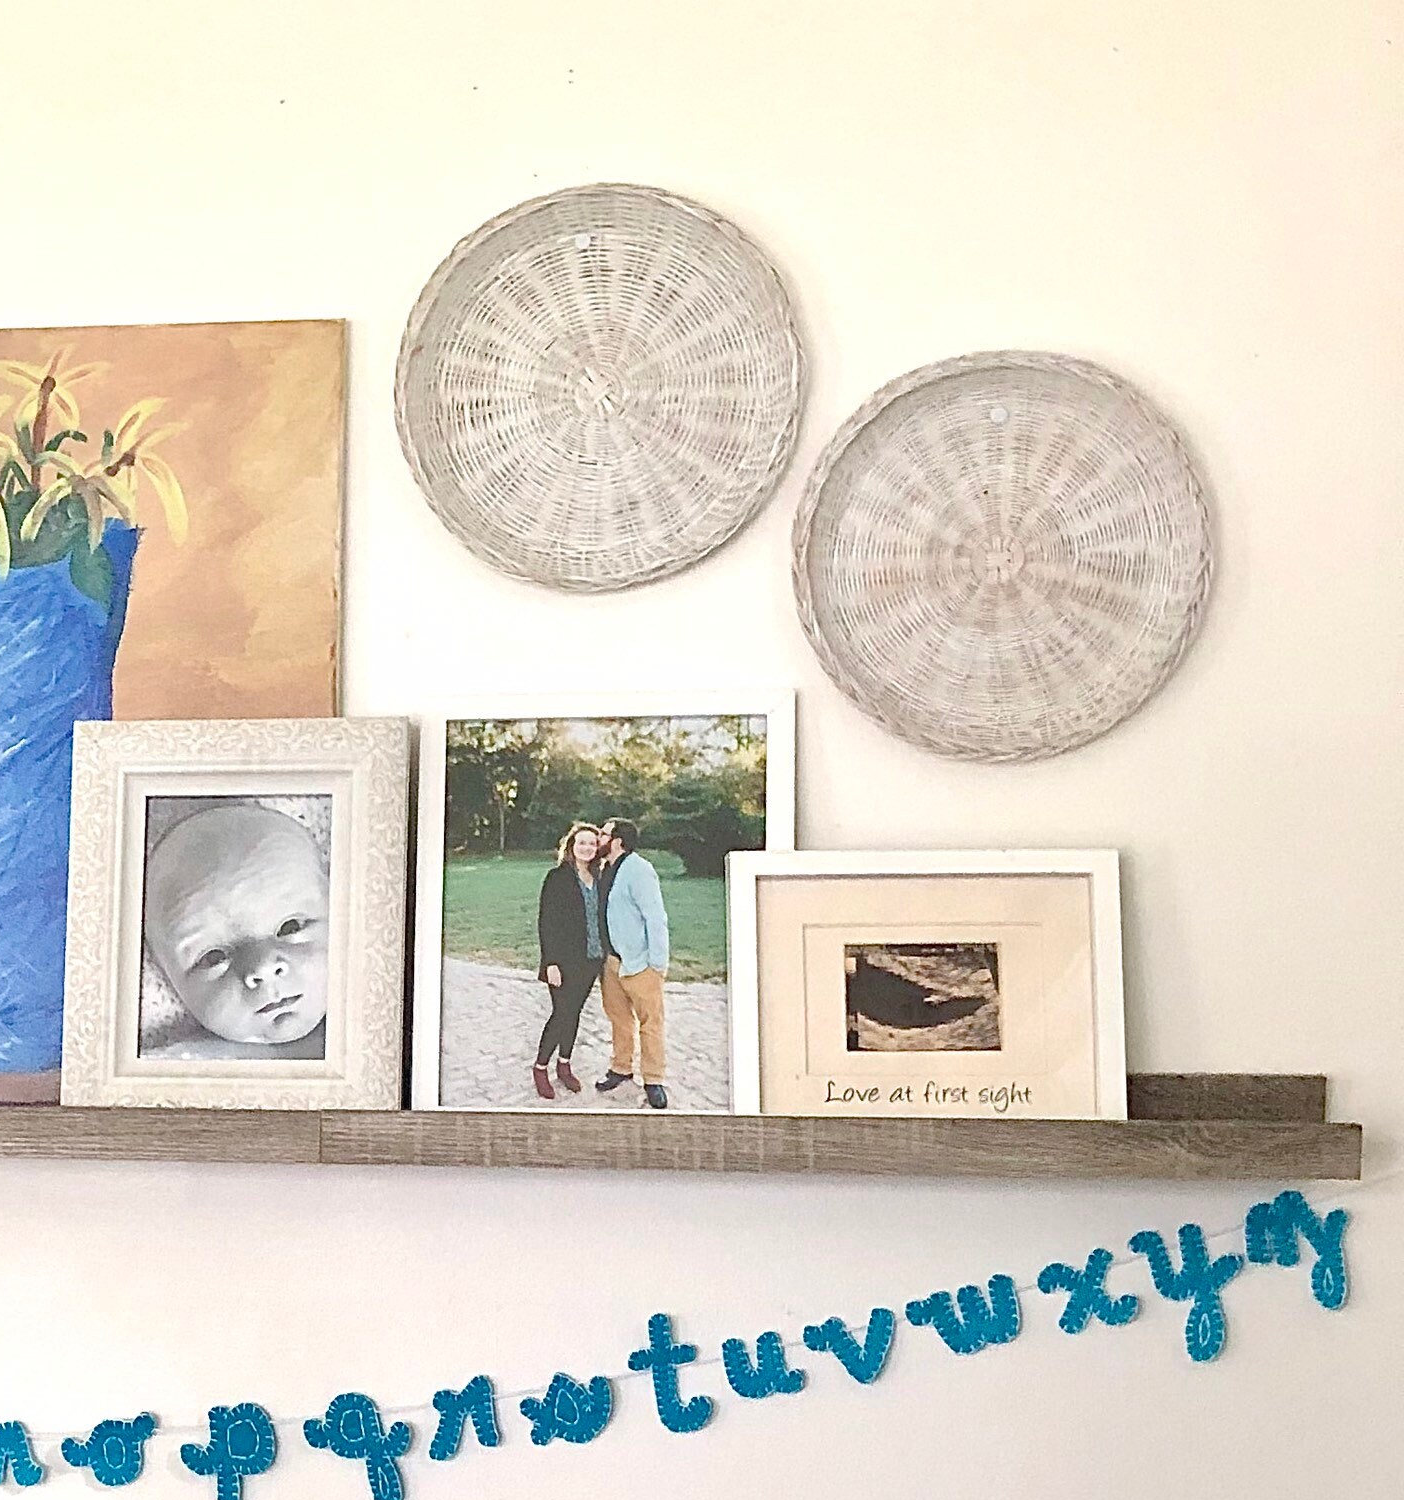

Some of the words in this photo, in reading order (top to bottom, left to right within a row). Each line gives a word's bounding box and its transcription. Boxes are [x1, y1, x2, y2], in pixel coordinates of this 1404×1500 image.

[824, 1080, 881, 1103] Love
[888, 1083, 914, 1103] at
[923, 1080, 969, 1104] first
[978, 1081, 1033, 1112] sight
